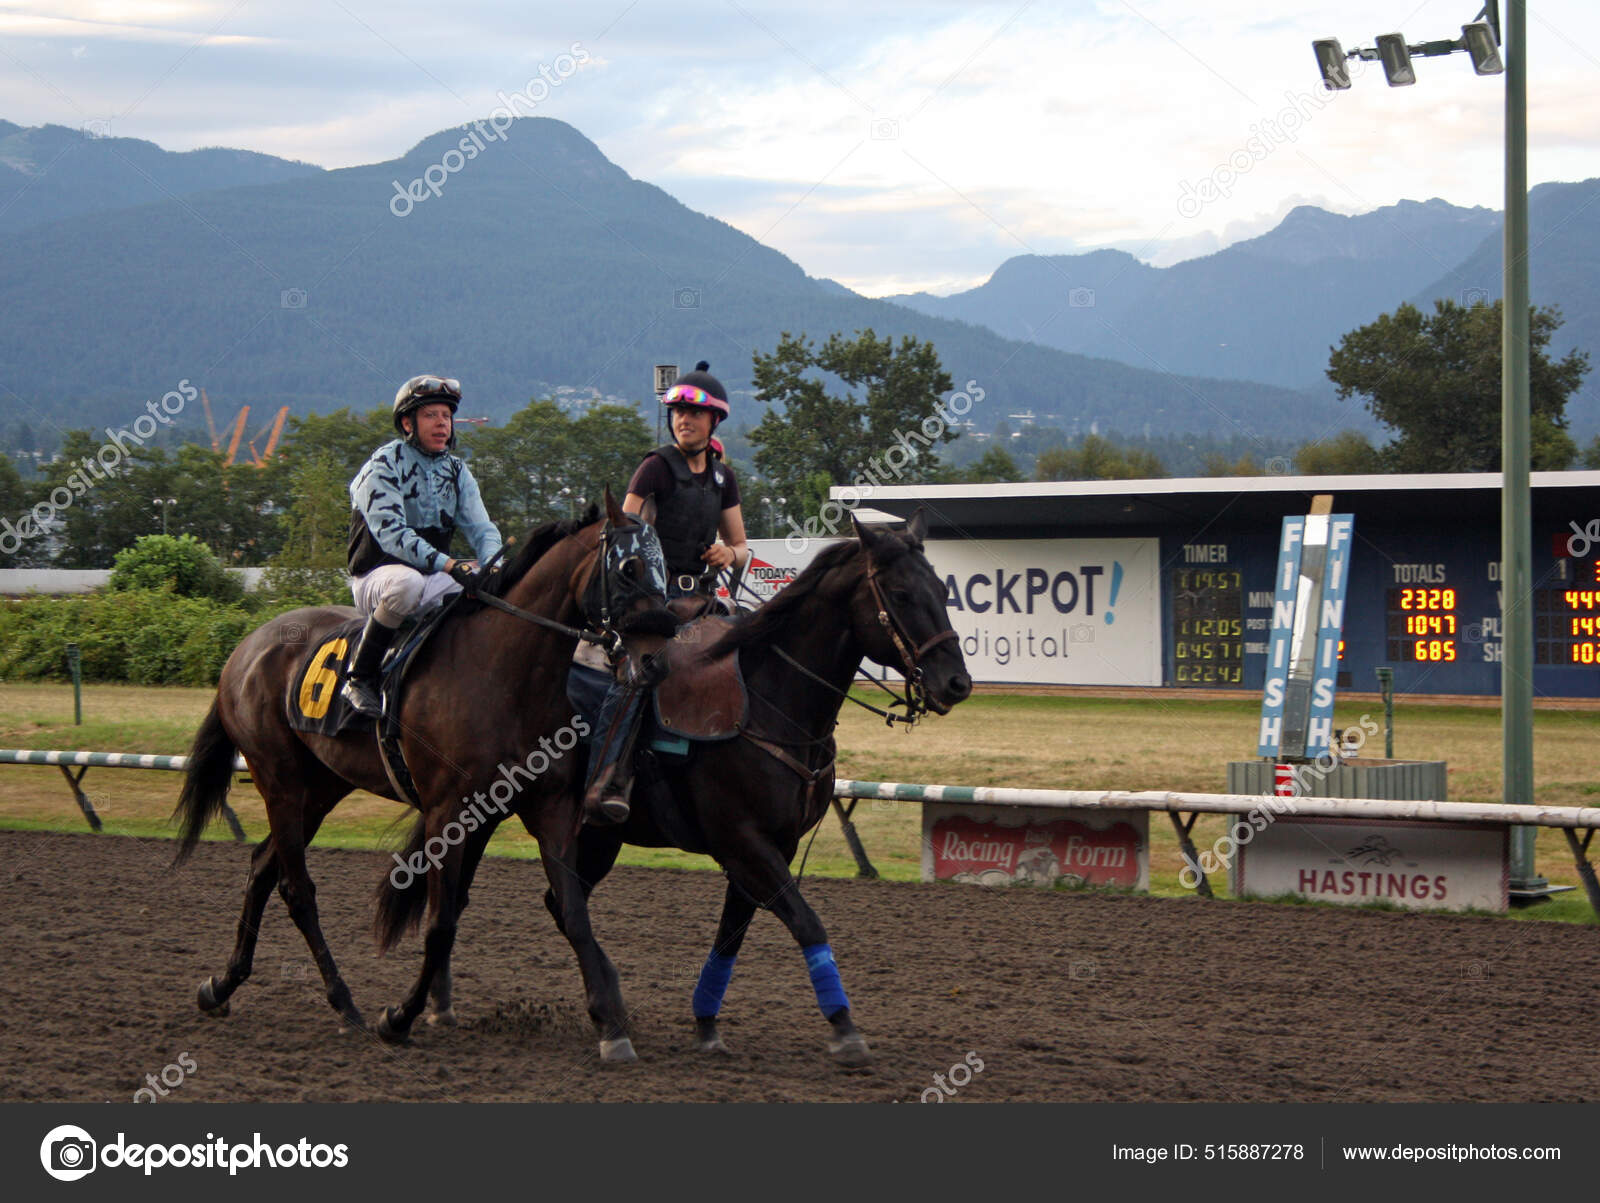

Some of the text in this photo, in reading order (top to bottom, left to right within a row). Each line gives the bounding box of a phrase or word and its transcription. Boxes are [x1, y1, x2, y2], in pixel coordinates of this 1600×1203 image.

[1184, 544, 1227, 563] TIMER
[752, 567, 797, 580] TODAY'S
[1392, 563, 1446, 583] TOTALS
[945, 560, 1124, 625] ACKPOT!
[1401, 588, 1455, 610] 2328
[1260, 523, 1302, 746] FINISH
[1307, 520, 1352, 746] FINISH
[1407, 614, 1455, 635] 1047
[963, 628, 1068, 665] digital
[1415, 640, 1455, 661] 685
[299, 638, 348, 719] 6
[941, 831, 1127, 868] Racing Form
[1299, 869, 1447, 900] HASTINGS
